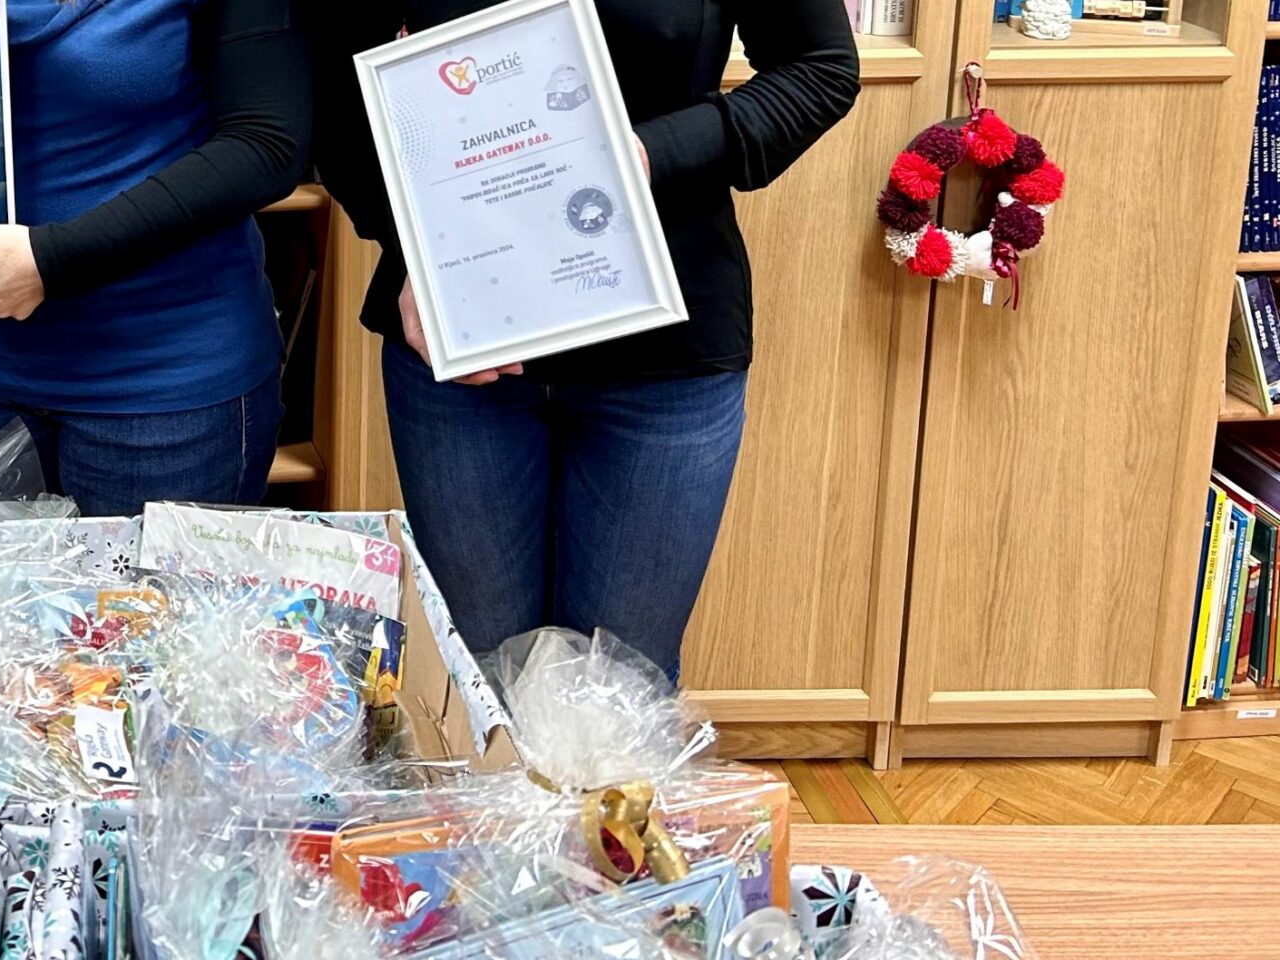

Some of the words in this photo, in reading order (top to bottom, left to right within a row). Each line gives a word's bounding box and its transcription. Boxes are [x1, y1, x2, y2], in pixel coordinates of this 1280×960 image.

[473, 51, 523, 83] portić
[459, 118, 537, 150] ZAHVALNICA
[453, 153, 484, 169] RIJEKA
[485, 139, 526, 159] GATEWAY
[1254, 310, 1268, 348] BEARS
